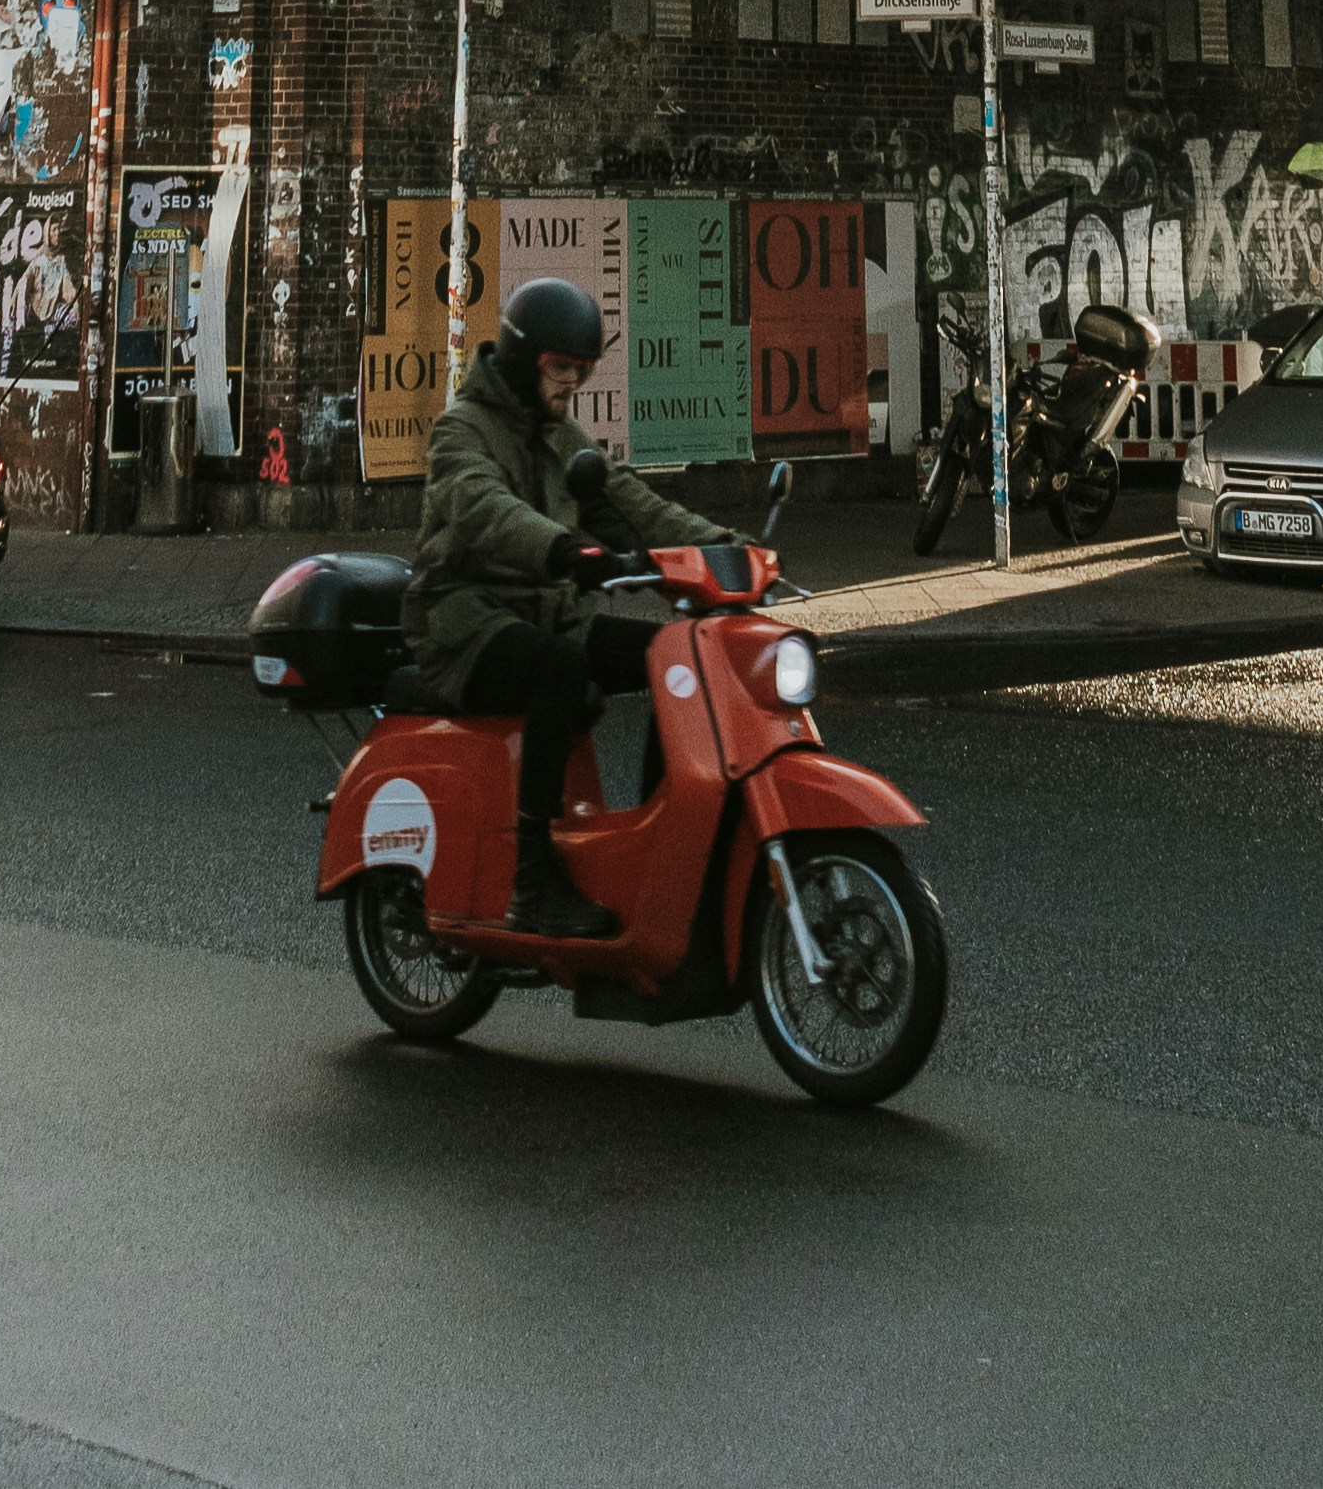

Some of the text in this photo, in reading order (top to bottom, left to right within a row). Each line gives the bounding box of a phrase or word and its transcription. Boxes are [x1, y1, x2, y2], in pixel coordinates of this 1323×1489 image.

[1005, 29, 1089, 54] Rosa-Luxemburg-Straße
[528, 186, 596, 199] Szeneplakatierung
[508, 217, 585, 248] MADE
[395, 220, 412, 310] NOCH
[755, 213, 860, 291] OH
[602, 216, 621, 351] MITTEN
[698, 218, 724, 366] SEELE
[368, 343, 450, 392] HÖF
[638, 337, 679, 368] DIE
[736, 340, 748, 417] LASSEN
[761, 344, 842, 417] DU
[573, 390, 621, 422] TTE
[634, 397, 726, 421] BUMMELN
[367, 417, 433, 439] WEIHN
[1269, 479, 1287, 490] KIA
[1243, 514, 1310, 533] B MG 7258
